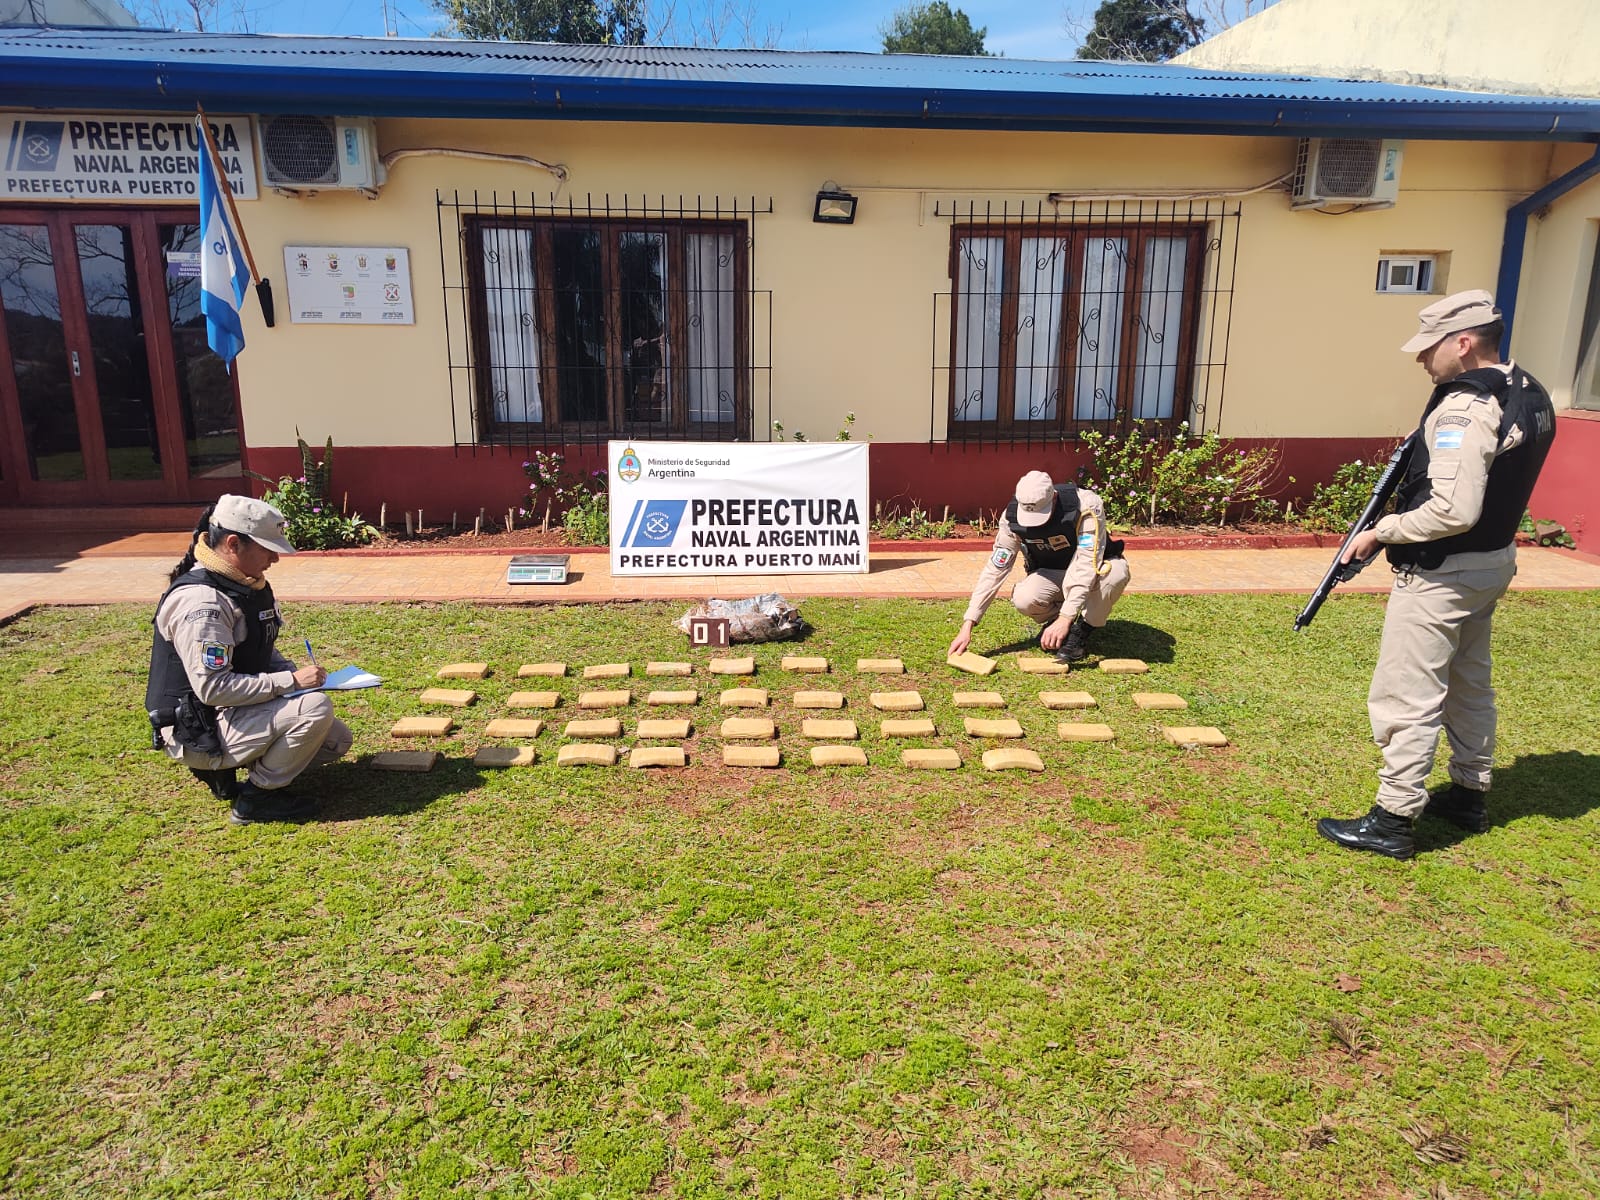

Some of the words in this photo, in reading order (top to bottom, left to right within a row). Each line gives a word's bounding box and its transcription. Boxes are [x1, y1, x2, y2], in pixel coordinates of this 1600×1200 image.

[68, 120, 240, 152] PREFECTURA
[73, 154, 134, 173] NAVAL
[139, 155, 243, 174] ARGENNA
[7, 178, 123, 194] PREFECTURA
[128, 180, 195, 195] PUERTO
[648, 458, 684, 466] Ministerio
[685, 458, 694, 467] de
[695, 458, 731, 468] Seguridad
[648, 468, 695, 479] Argentina
[692, 498, 860, 526] PREFECTURA
[692, 530, 751, 548] NAVAL
[756, 530, 860, 547] ARGENTINA
[620, 554, 738, 568] PREFECTURA
[745, 553, 813, 567] PUERTO
[818, 550, 860, 566] MANÍ
